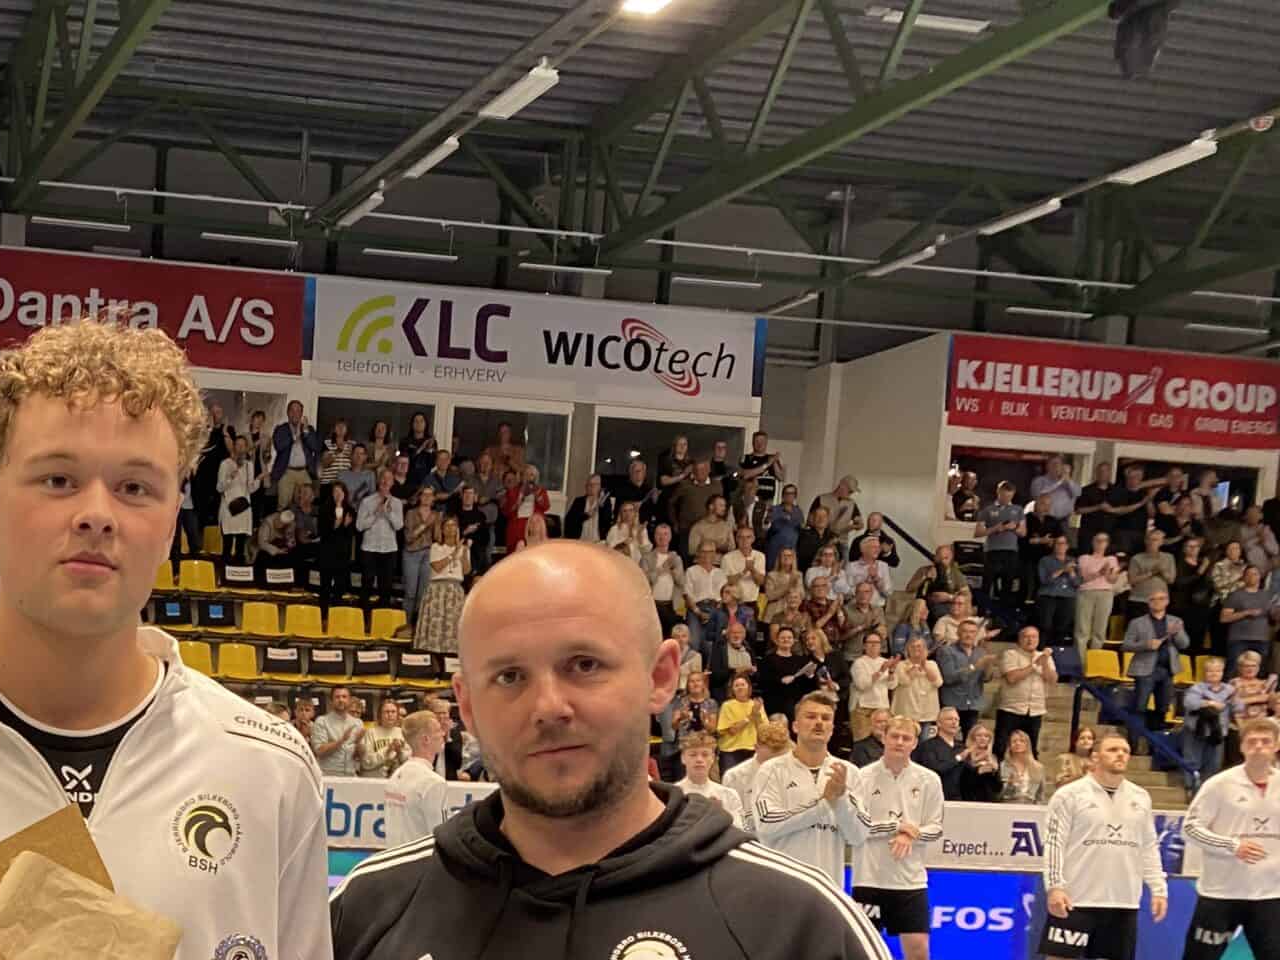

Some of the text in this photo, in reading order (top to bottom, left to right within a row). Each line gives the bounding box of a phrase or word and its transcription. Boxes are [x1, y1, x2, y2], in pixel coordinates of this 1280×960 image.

[178, 294, 275, 347] A/S
[401, 297, 512, 363] KLC
[337, 357, 508, 384] telefoni til ERHVERV
[543, 329, 736, 380] WICOtech
[956, 359, 1277, 414] KJELLERUP GROUP
[955, 396, 980, 413] VVS
[1001, 401, 1029, 417] BLIK
[1051, 404, 1128, 425] VENTILATION
[1149, 413, 1174, 428] GAS
[188, 855, 218, 875] BSH
[1048, 926, 1090, 947] ILVA
